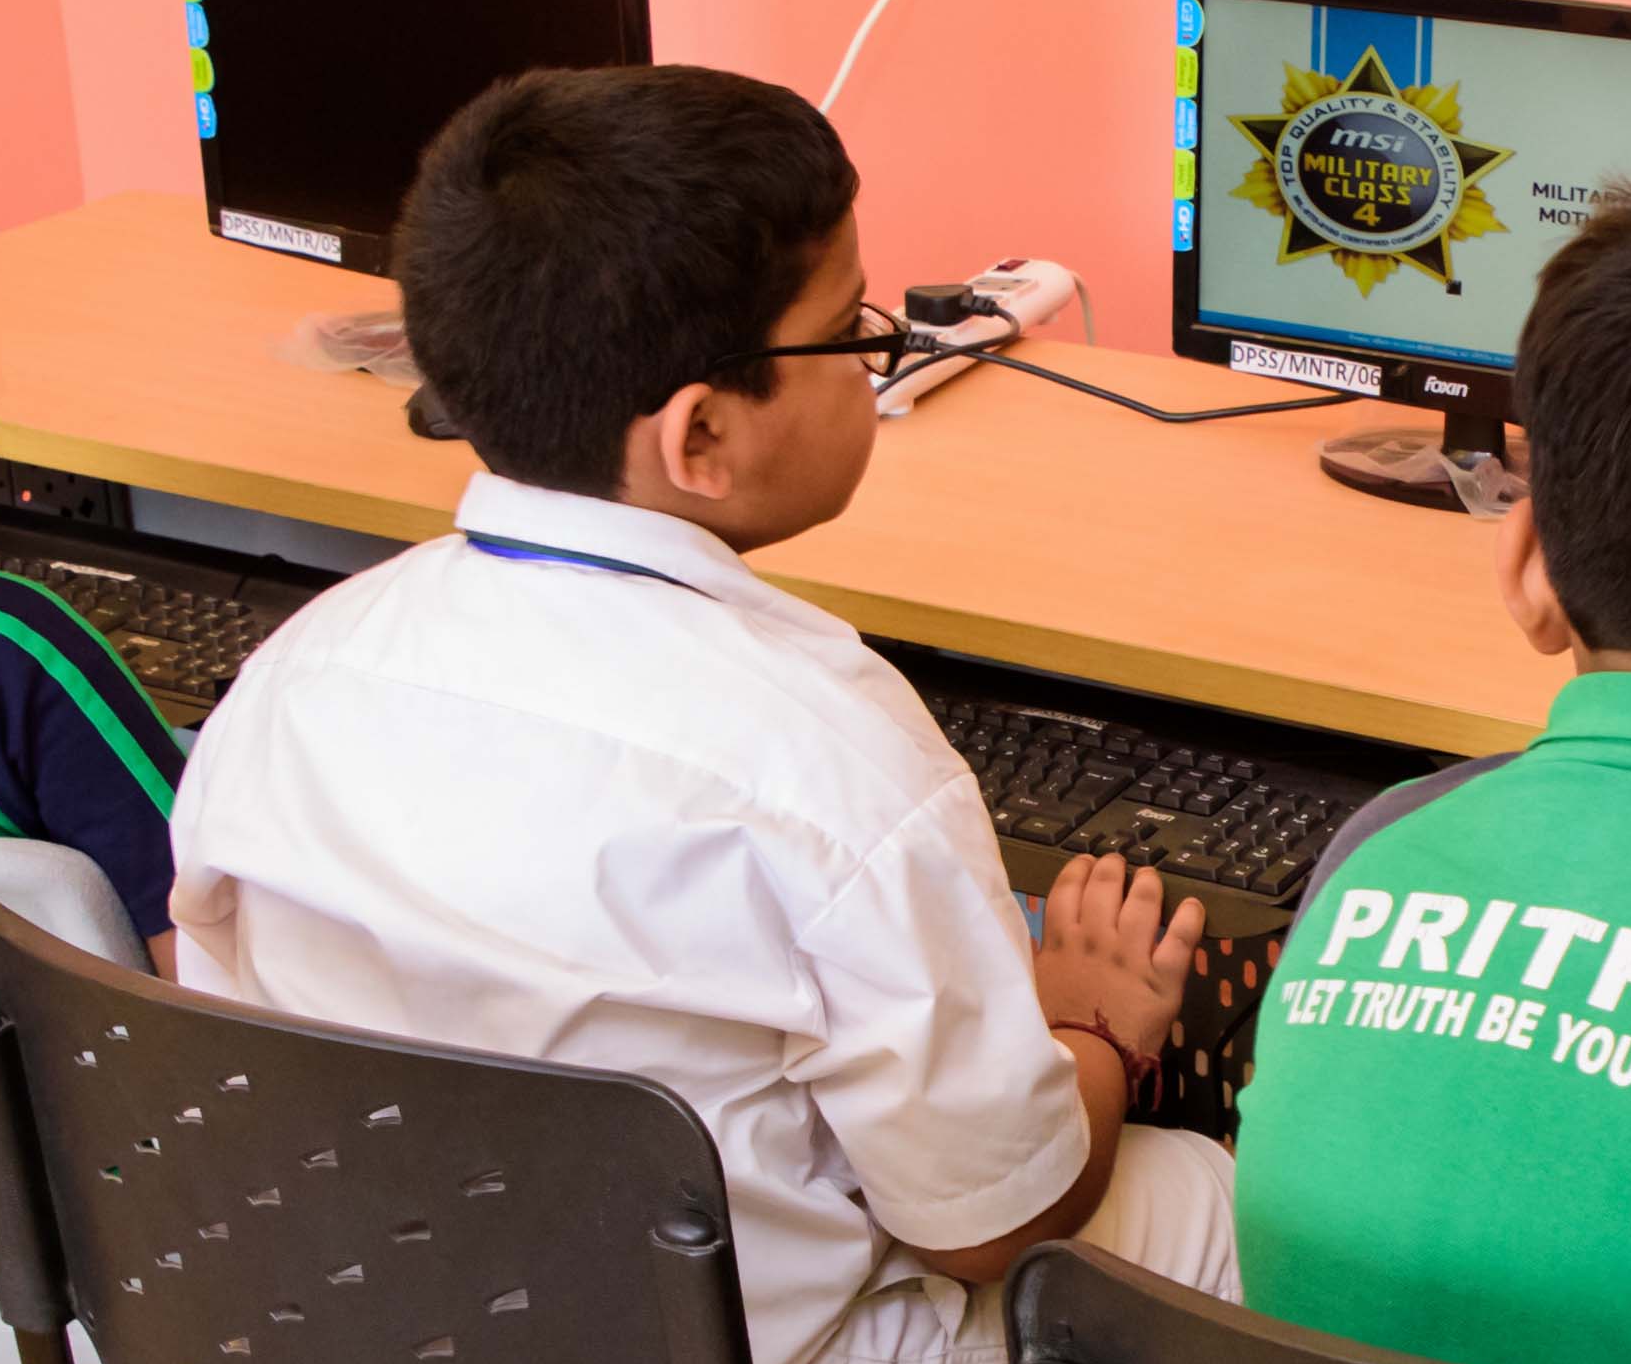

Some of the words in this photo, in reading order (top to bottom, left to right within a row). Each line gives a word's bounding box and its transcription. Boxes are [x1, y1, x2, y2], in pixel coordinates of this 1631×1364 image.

[1281, 145, 1296, 187] TOP
[1290, 98, 1375, 140] QUALITY
[1382, 102, 1399, 116] &
[1403, 112, 1457, 211] STABILITY
[1330, 127, 1407, 153] msi
[1304, 153, 1433, 187] MILITARY
[1324, 177, 1412, 206] CLASS
[1178, 206, 1191, 232] HD
[1353, 203, 1381, 227] 4
[1231, 344, 1381, 388] DPSS/MNTR/06
[1348, 981, 1476, 1038] TRUTH
[1476, 994, 1546, 1049] BE
